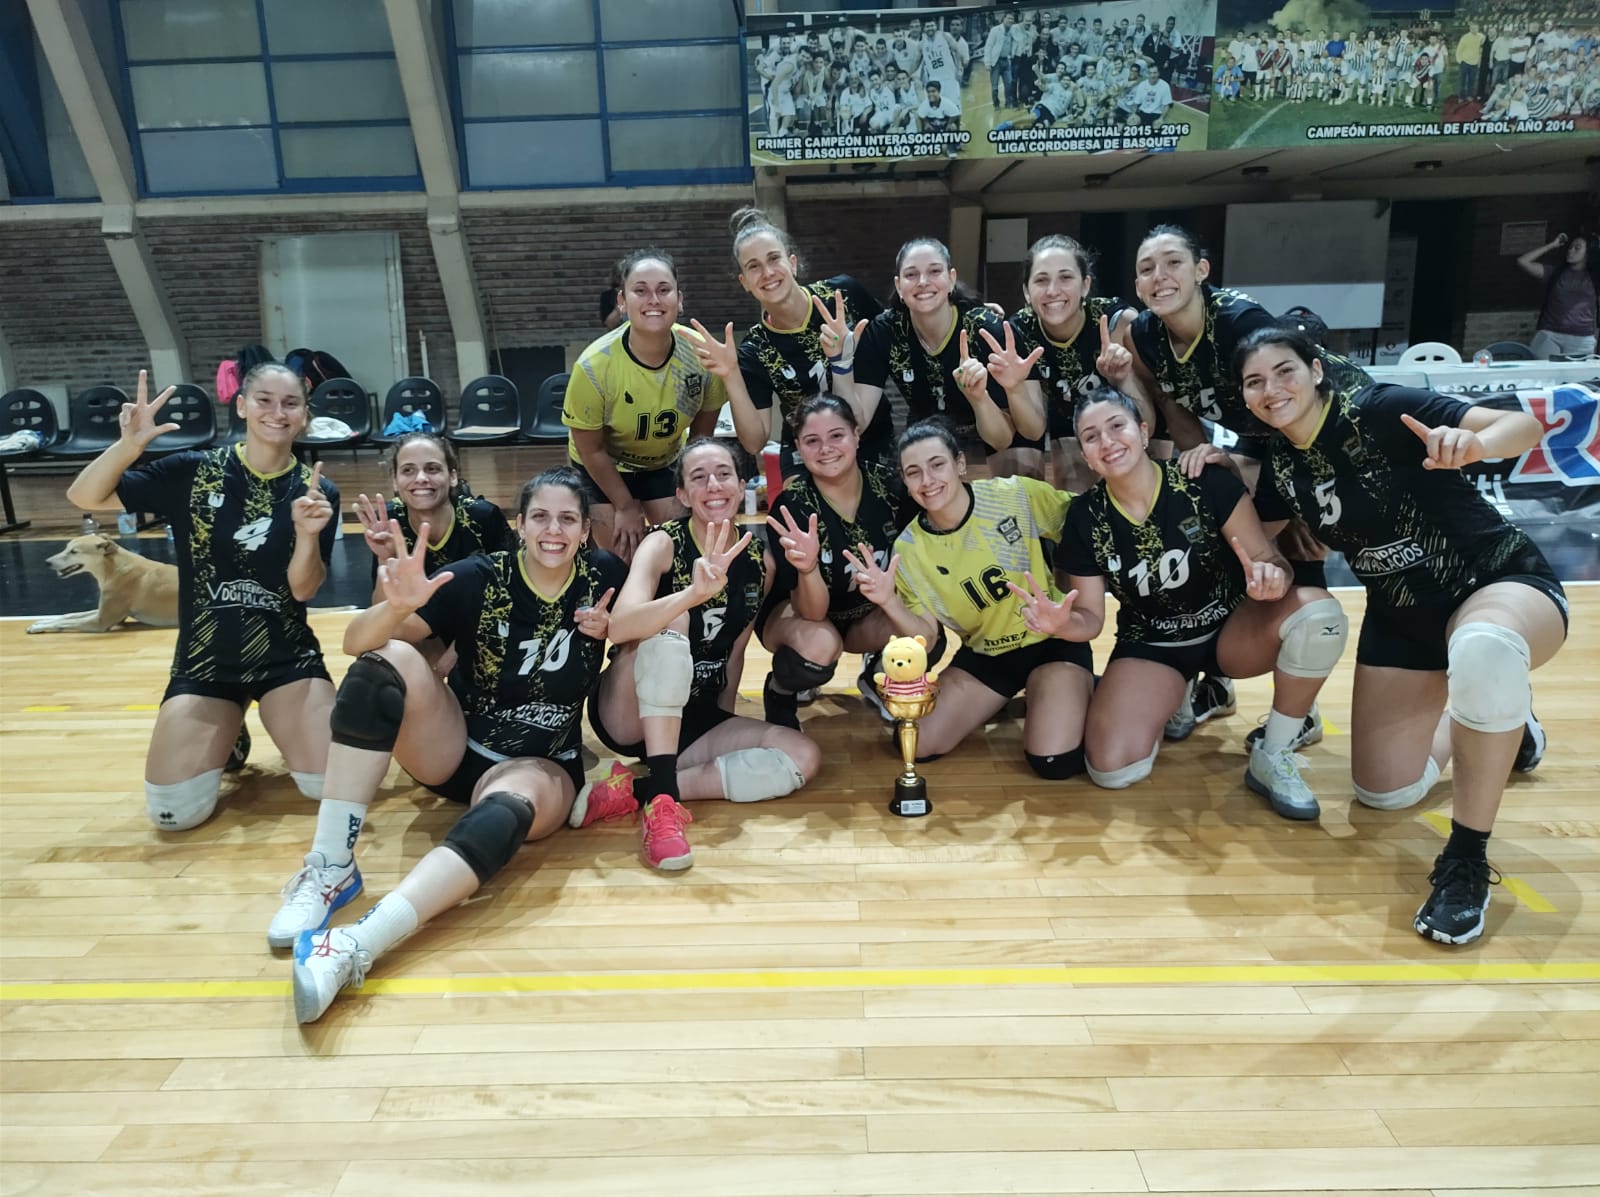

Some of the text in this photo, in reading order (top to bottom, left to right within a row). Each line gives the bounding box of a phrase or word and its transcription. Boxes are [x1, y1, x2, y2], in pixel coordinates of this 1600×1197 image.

[757, 131, 971, 150] PRIMER CAMPEÓN INTERASOCIATIVO
[988, 128, 1046, 142] CAMPEÓN
[1049, 126, 1121, 140] PROVINCIAL
[1123, 125, 1151, 137] 2015
[1161, 124, 1190, 136] 2016
[998, 136, 1179, 153] LIGA CORDOBESA DE BASQUET
[1307, 120, 1575, 139] CAMPEÓN PROVINCIAL DE FÚTBOL AÑO 2014
[786, 142, 942, 160] DE BASQUETBOL AÑO 2015
[635, 408, 679, 441] 13
[1315, 478, 1342, 528] 5
[233, 516, 273, 551] 4
[1128, 546, 1192, 597] 10
[959, 564, 1014, 613] 16
[700, 607, 727, 641] 6
